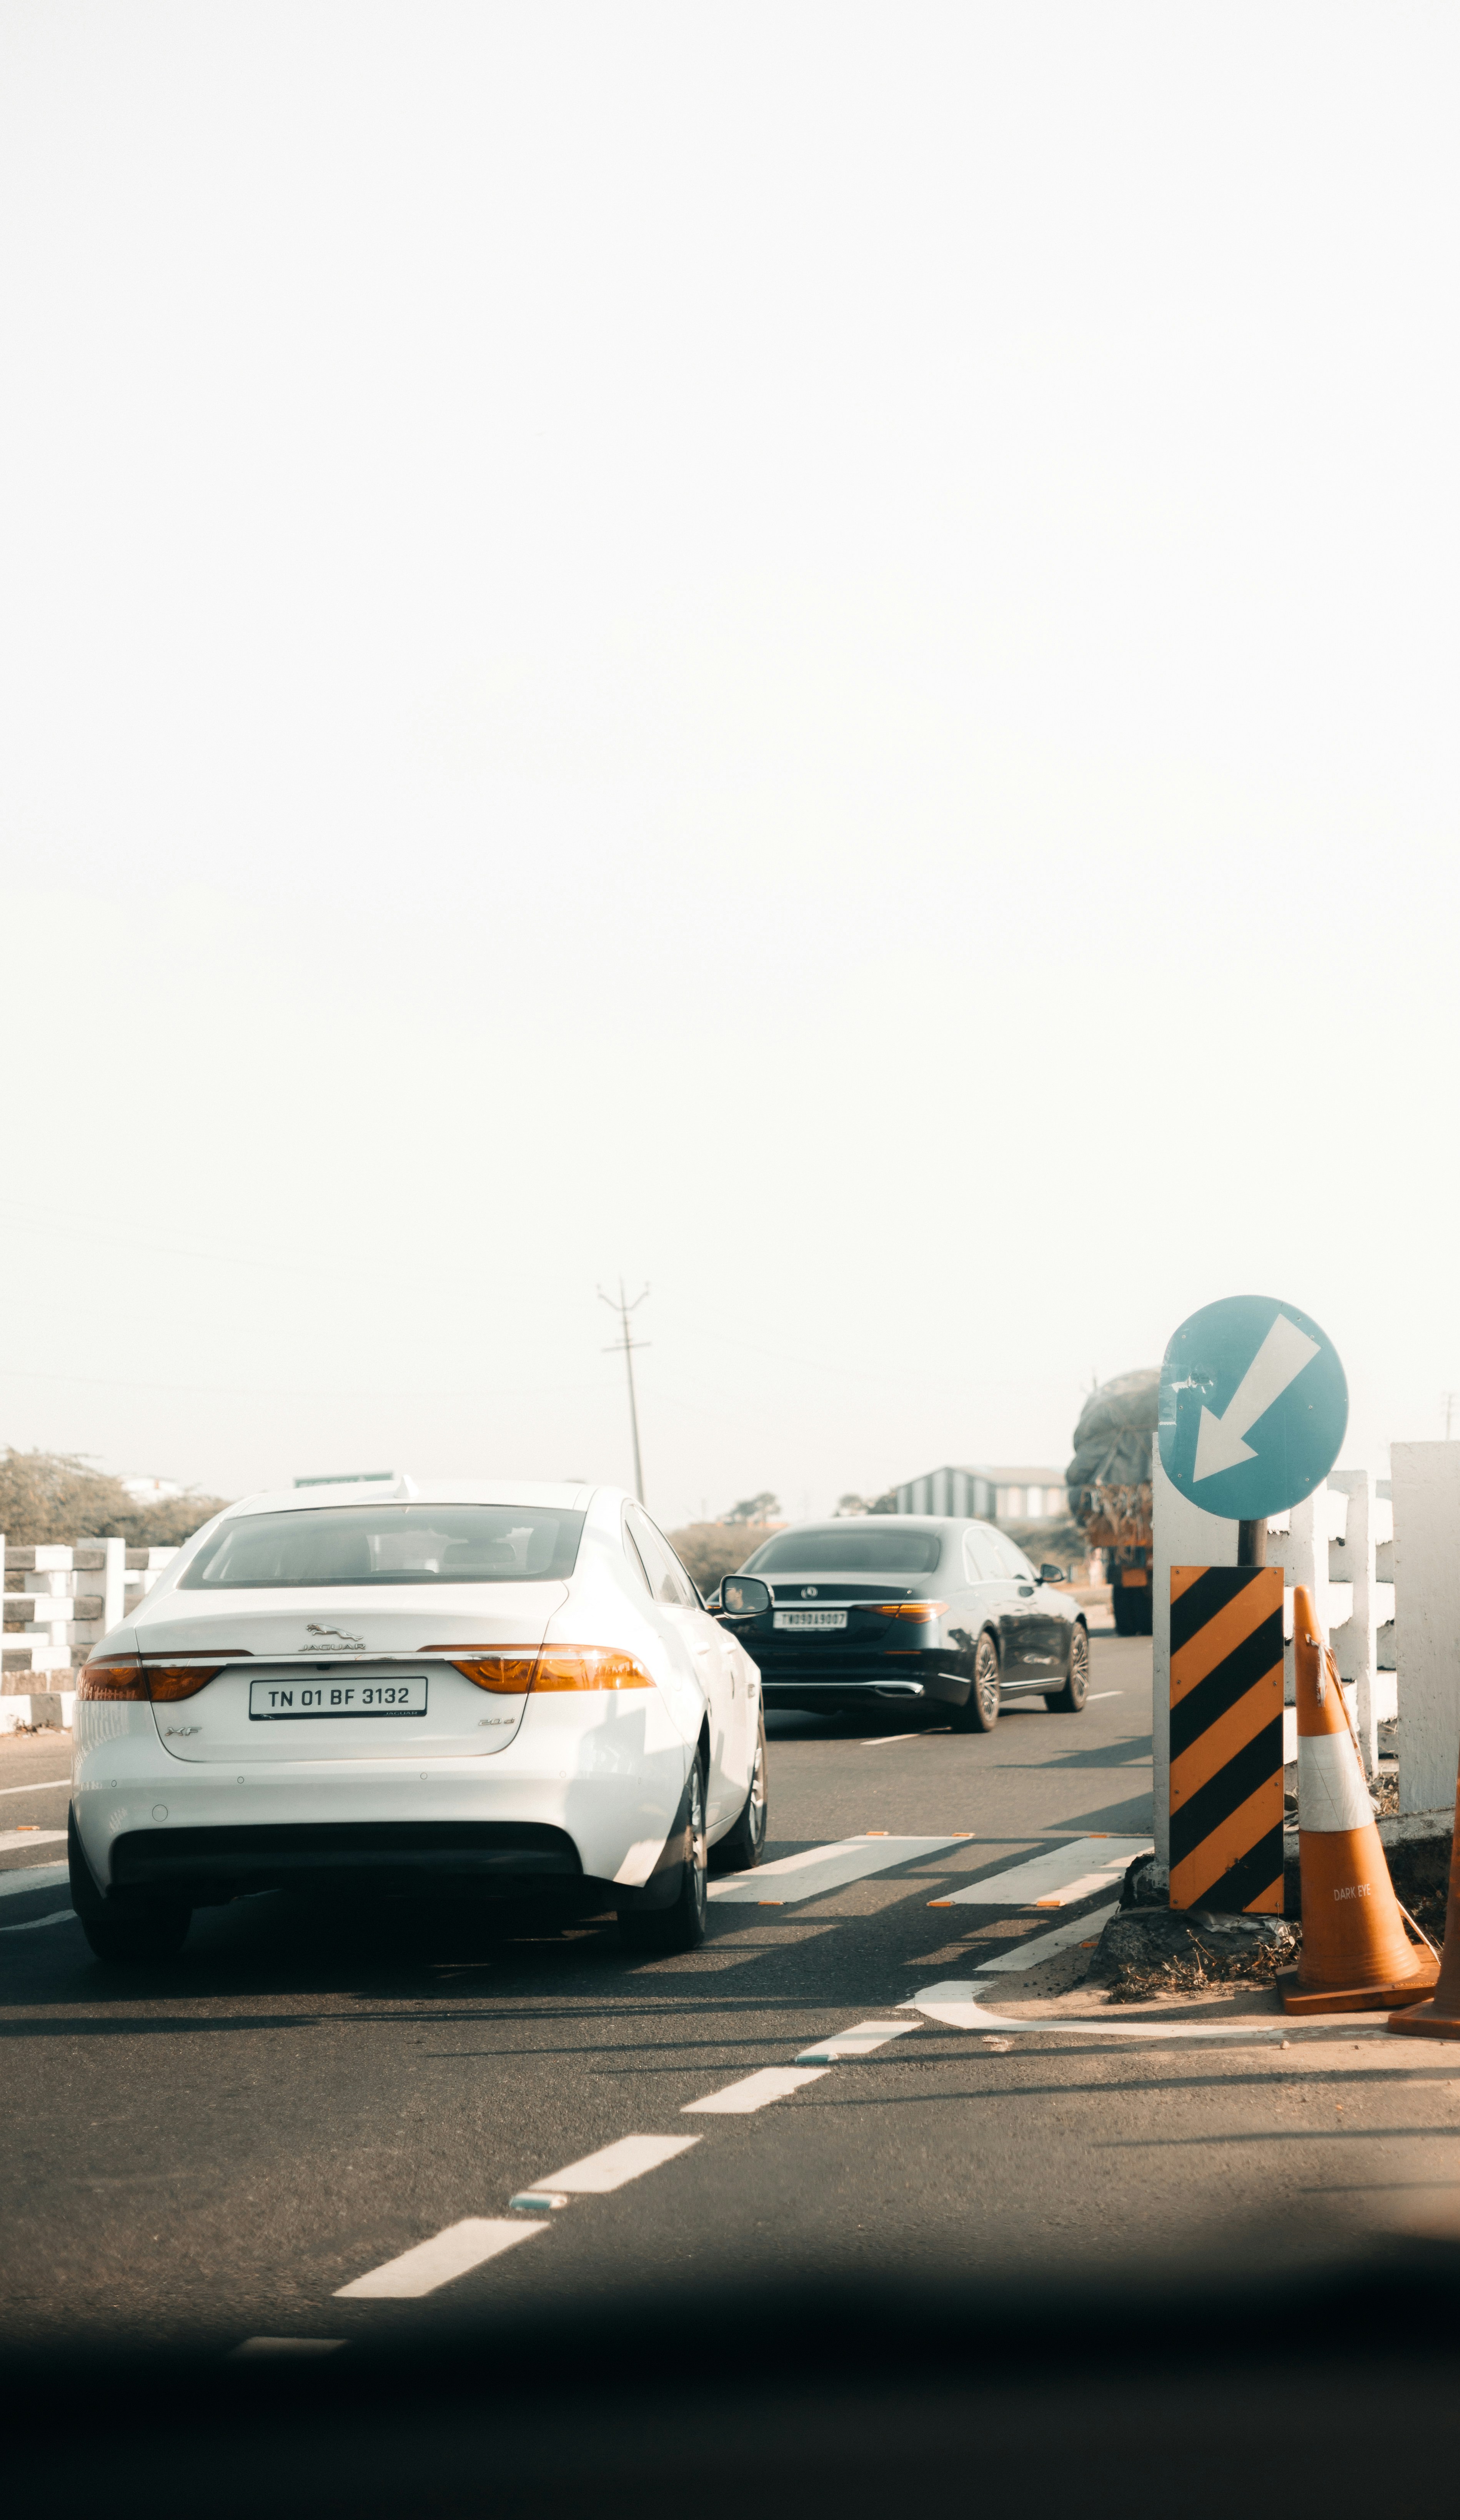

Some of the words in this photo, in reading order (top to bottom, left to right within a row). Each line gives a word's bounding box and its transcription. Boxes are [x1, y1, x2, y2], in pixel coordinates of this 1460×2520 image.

[298, 1643, 366, 1651] JAGUAR
[268, 1691, 293, 1707] TN
[301, 1690, 321, 1706] 01
[331, 1689, 355, 1705] BF
[362, 1688, 409, 1704] 3132
[165, 1727, 202, 1736] XF
[1334, 1886, 1356, 1901] DARK
[1358, 1884, 1371, 1897] EYE
